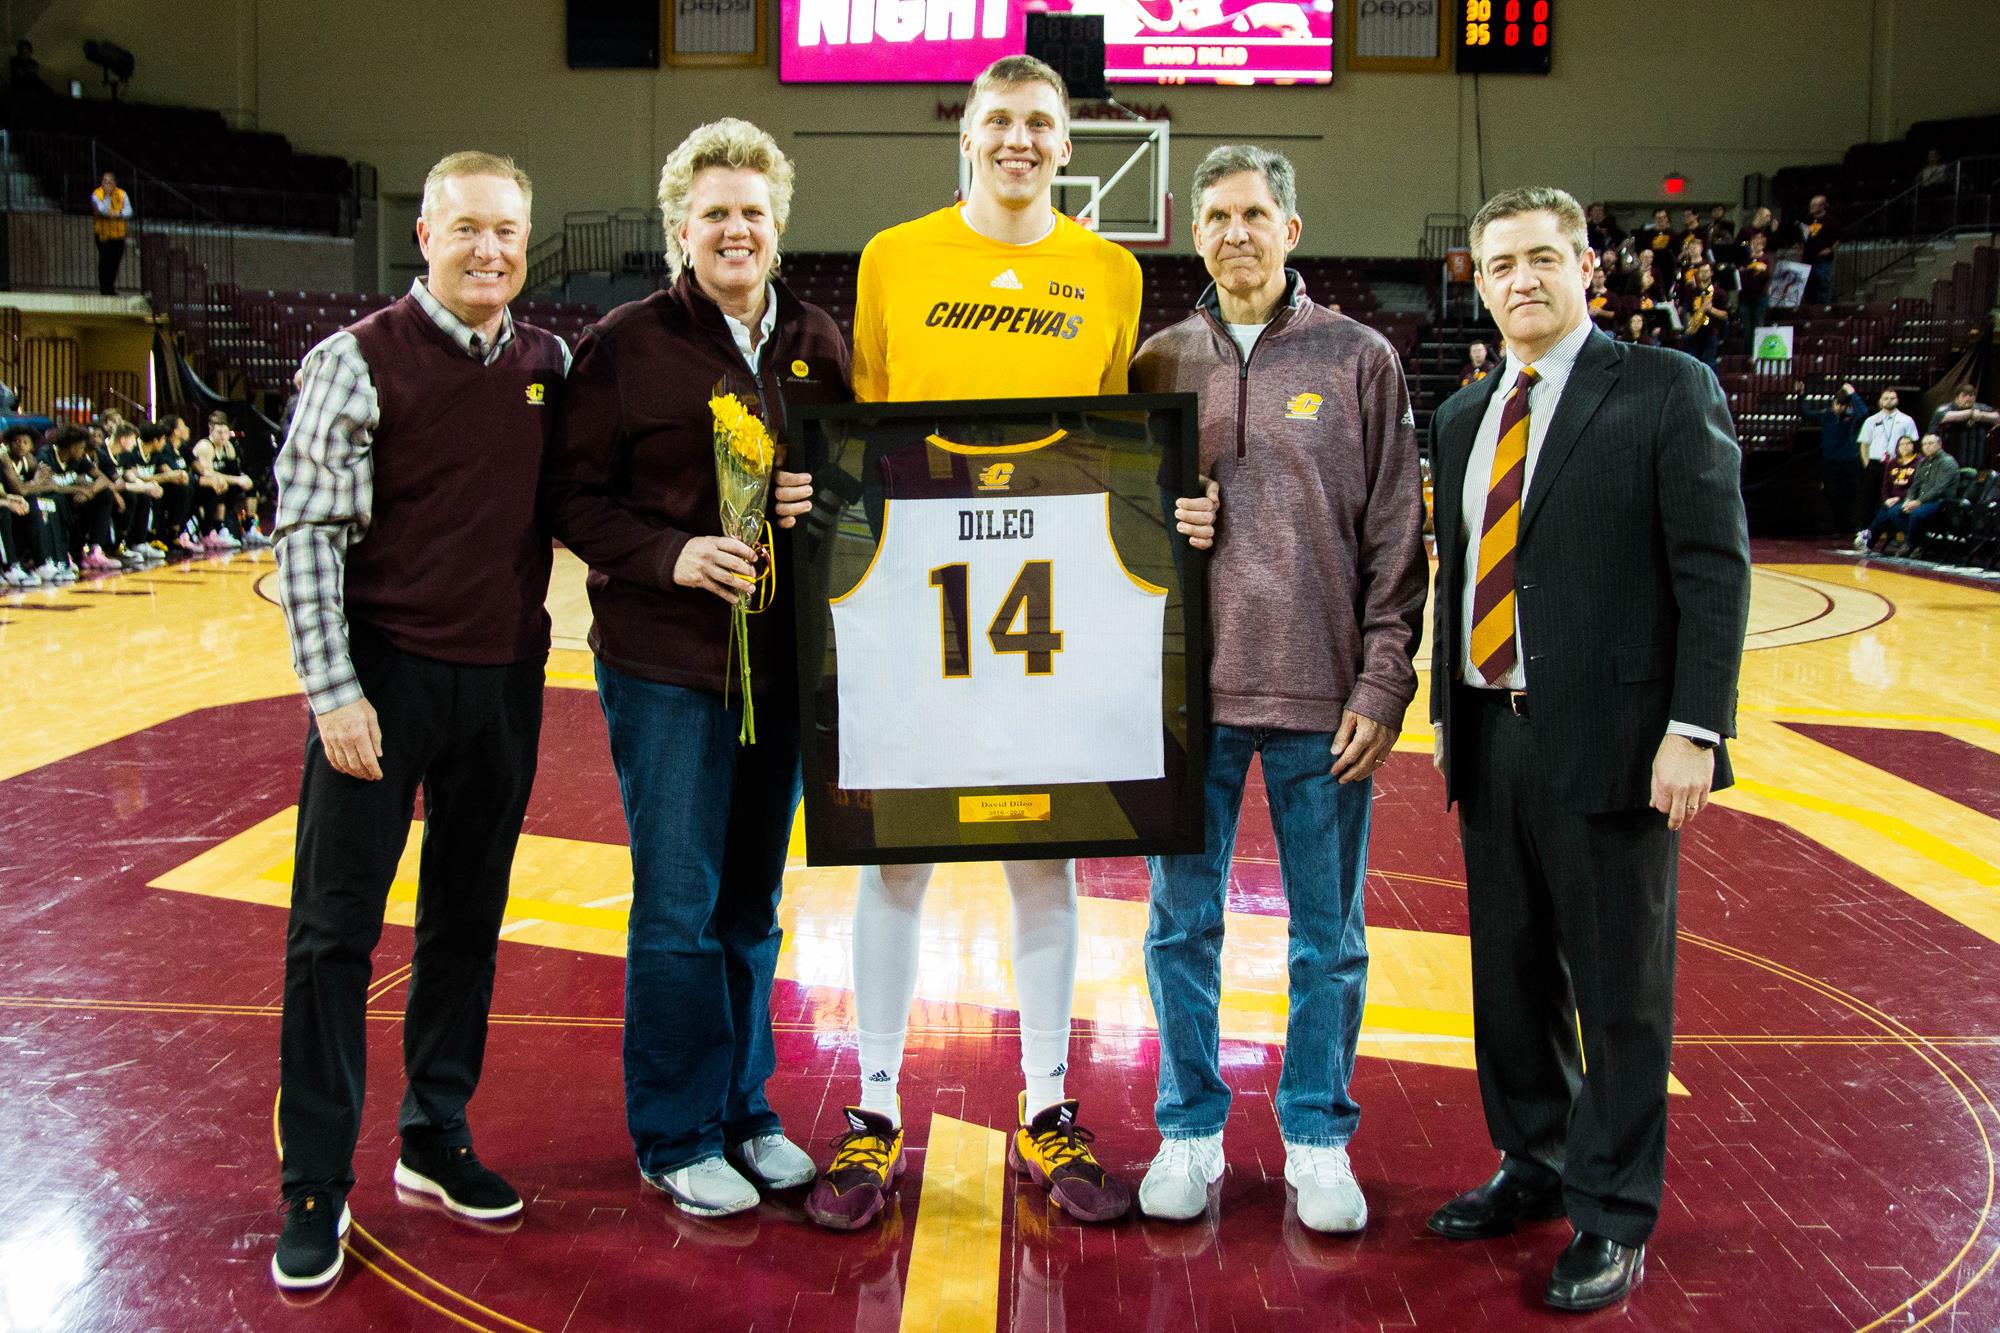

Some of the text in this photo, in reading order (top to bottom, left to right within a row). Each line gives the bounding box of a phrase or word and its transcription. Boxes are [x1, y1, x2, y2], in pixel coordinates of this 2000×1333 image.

[1361, 0, 1433, 18] pepsi
[1048, 281, 1085, 300] DON
[925, 301, 1084, 340] CHIPPEWAS
[958, 508, 1035, 541] DILEO
[928, 559, 1064, 679] 14
[981, 801, 1007, 809] David
